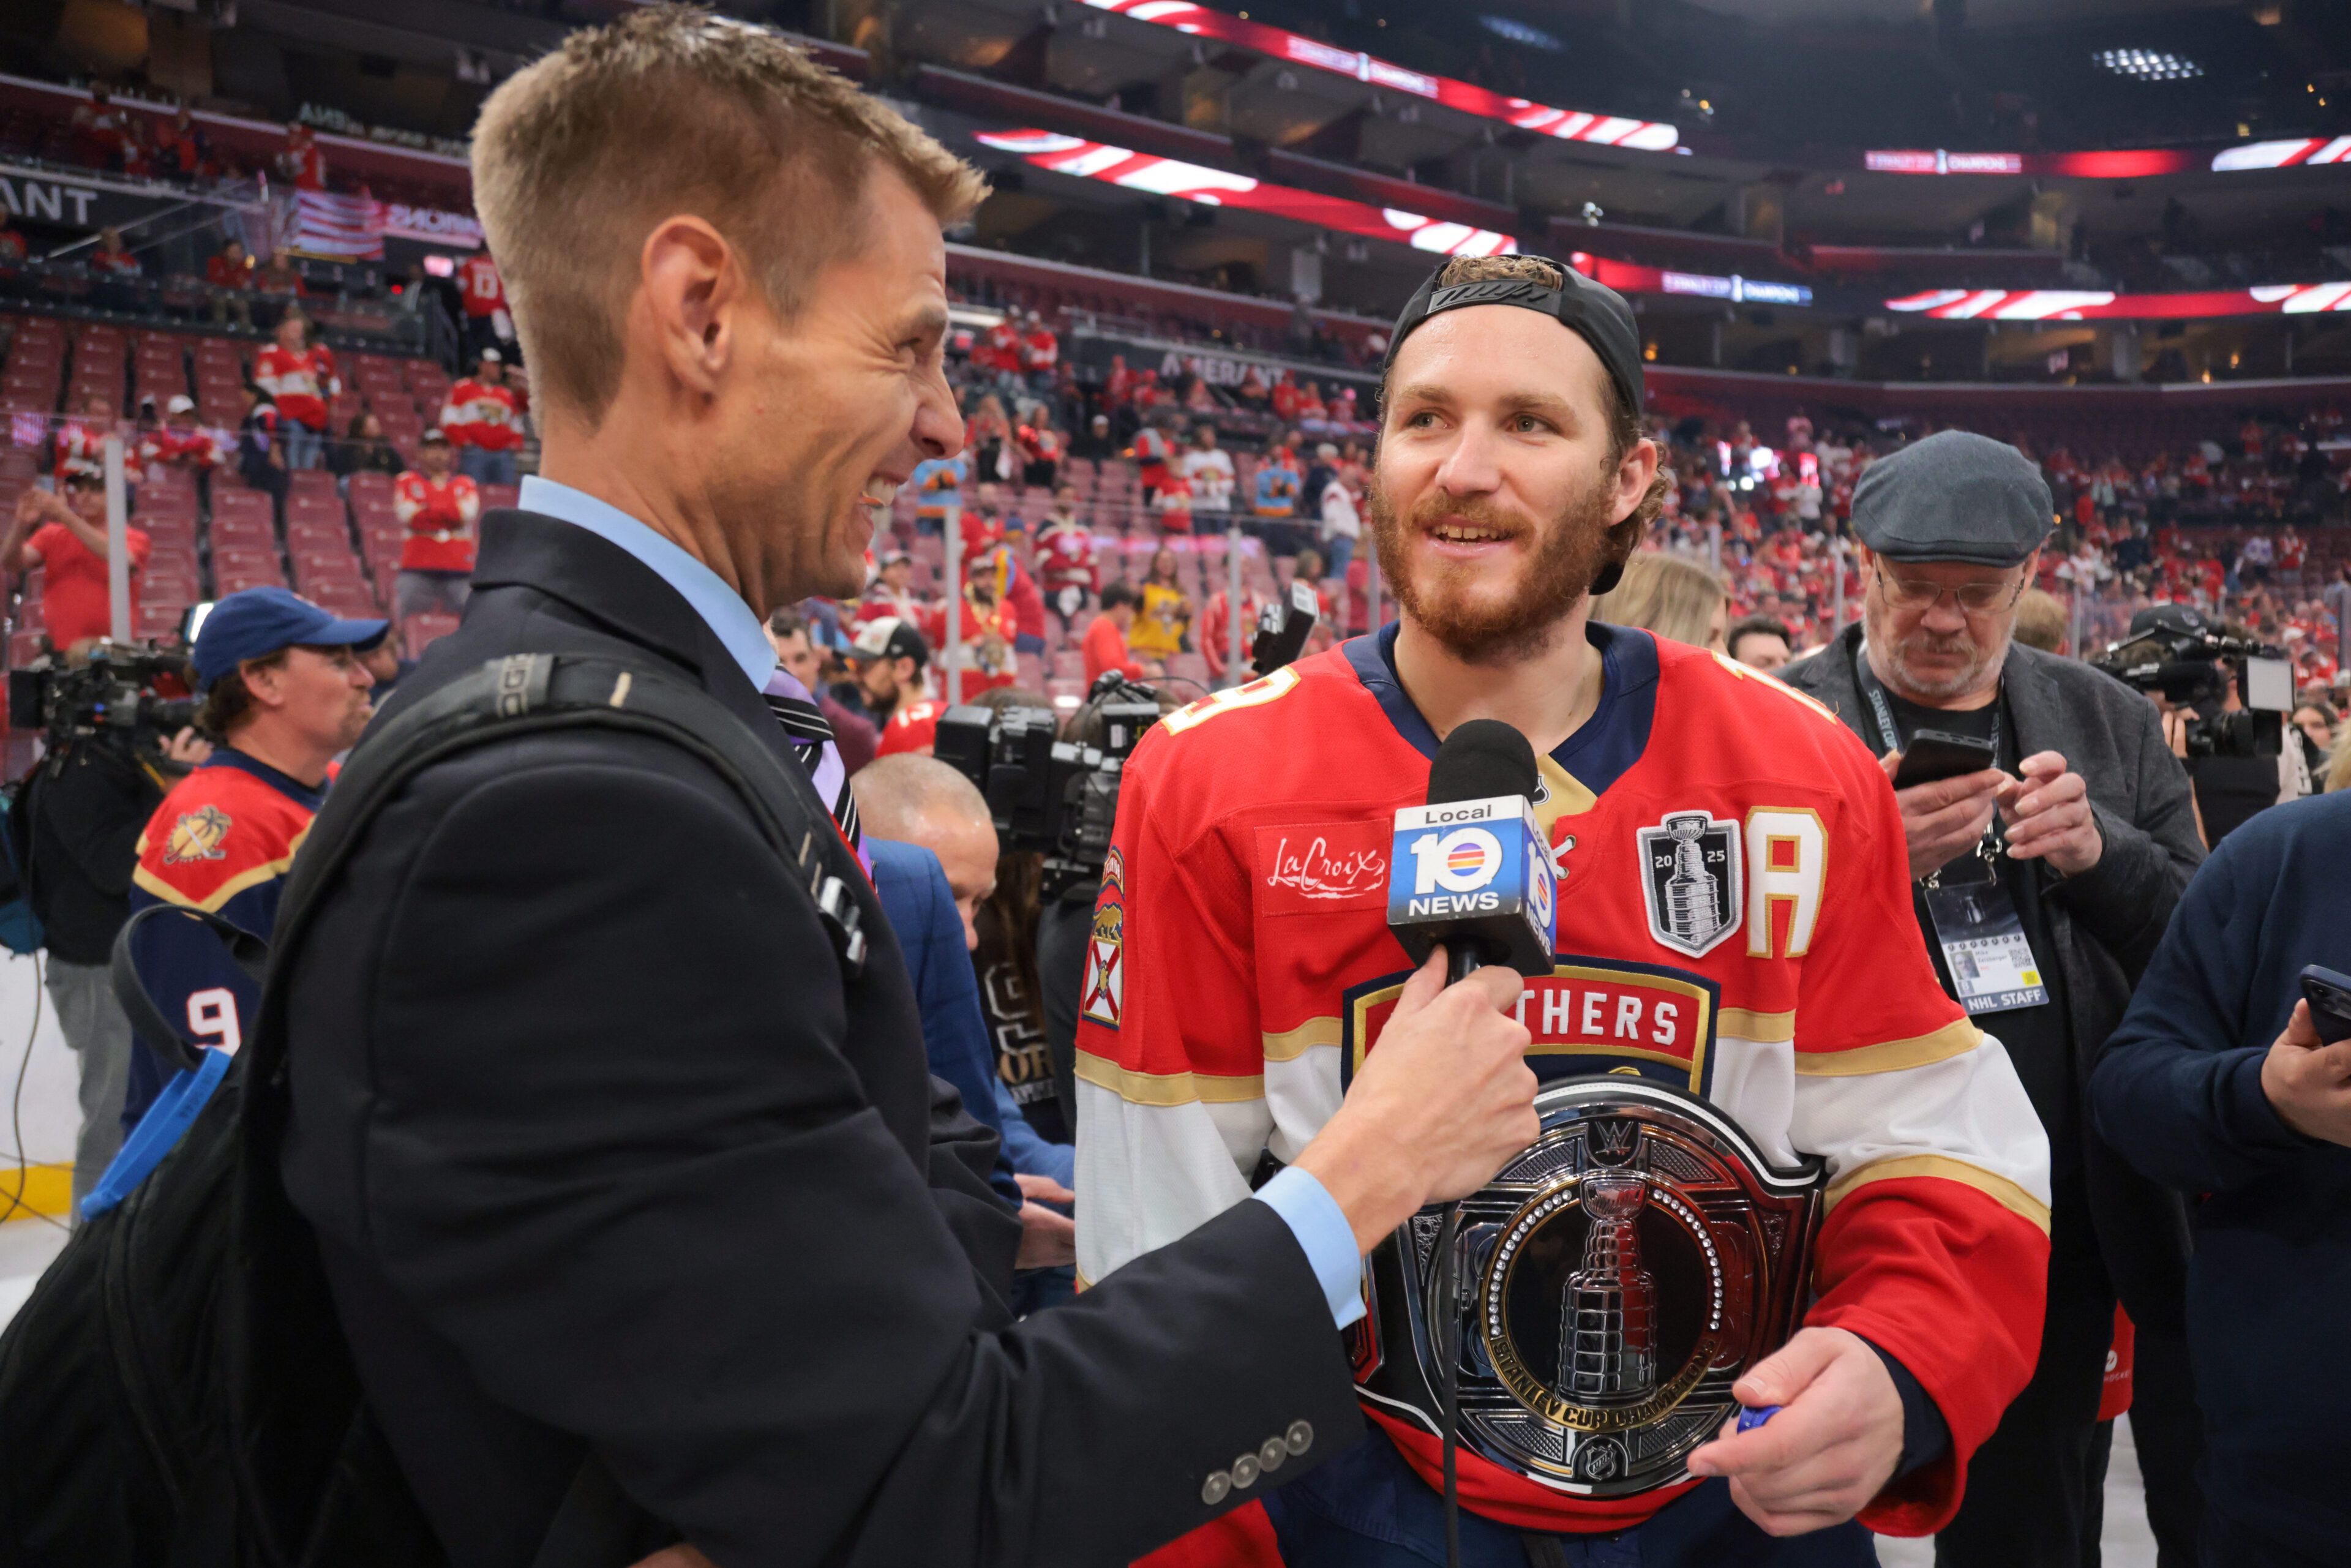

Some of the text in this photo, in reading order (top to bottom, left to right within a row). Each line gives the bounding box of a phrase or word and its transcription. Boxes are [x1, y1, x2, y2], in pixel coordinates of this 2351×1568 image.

[1425, 804, 1492, 825] Local
[1532, 818, 1550, 863] Local
[1267, 836, 1385, 891] LaCroix
[1410, 827, 1503, 895] 10
[1528, 840, 1553, 928] 10
[1655, 855, 1673, 869] 20
[1707, 850, 1726, 864] 25
[1745, 805, 1829, 960] A
[1409, 891, 1500, 917] NEWS
[1526, 901, 1551, 958] NEWS
[186, 987, 242, 1057] 9
[1967, 989, 2041, 1011] NHL STAFF
[1493, 1341, 1563, 1417] STANLEY
[1562, 1407, 1608, 1429] CUP
